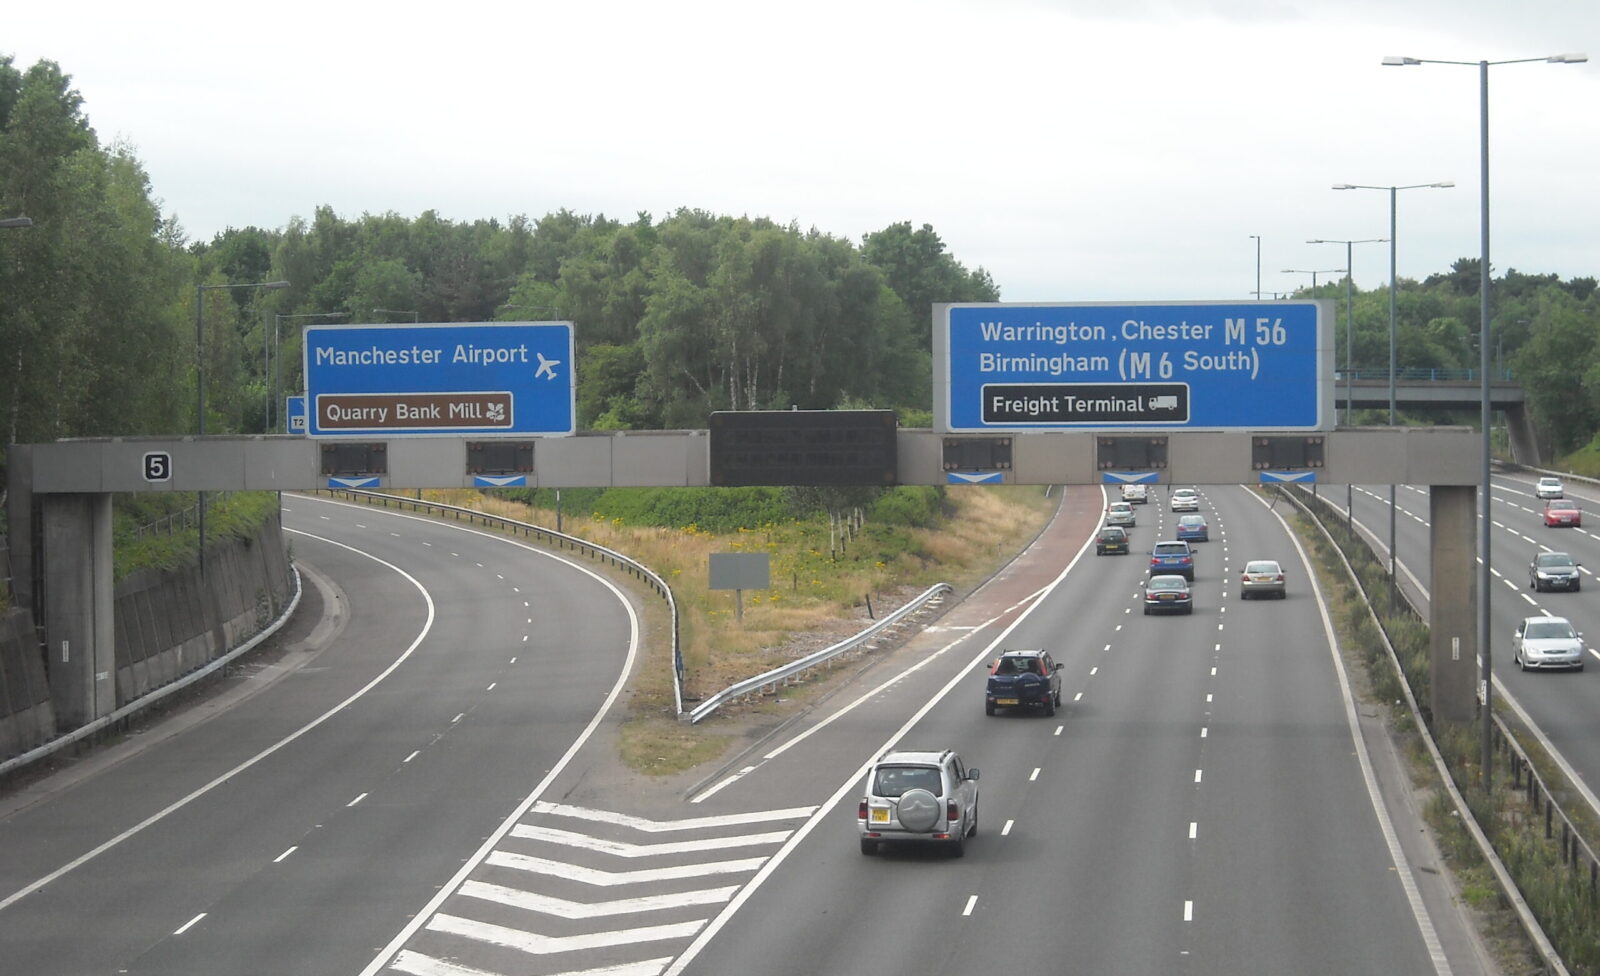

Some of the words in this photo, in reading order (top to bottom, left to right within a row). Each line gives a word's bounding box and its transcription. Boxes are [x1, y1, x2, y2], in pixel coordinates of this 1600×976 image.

[1121, 320, 1213, 341] Chester
[316, 346, 442, 365] Manchester
[452, 344, 528, 366] Airport
[979, 352, 1109, 376] Birmingham
[1183, 347, 1260, 380] South)
[326, 404, 388, 423] Quarry
[396, 403, 441, 419] Bank
[449, 402, 482, 418] Mill
[992, 396, 1059, 416] Freight
[1064, 395, 1145, 413] Terminal
[150, 457, 164, 476] 5
